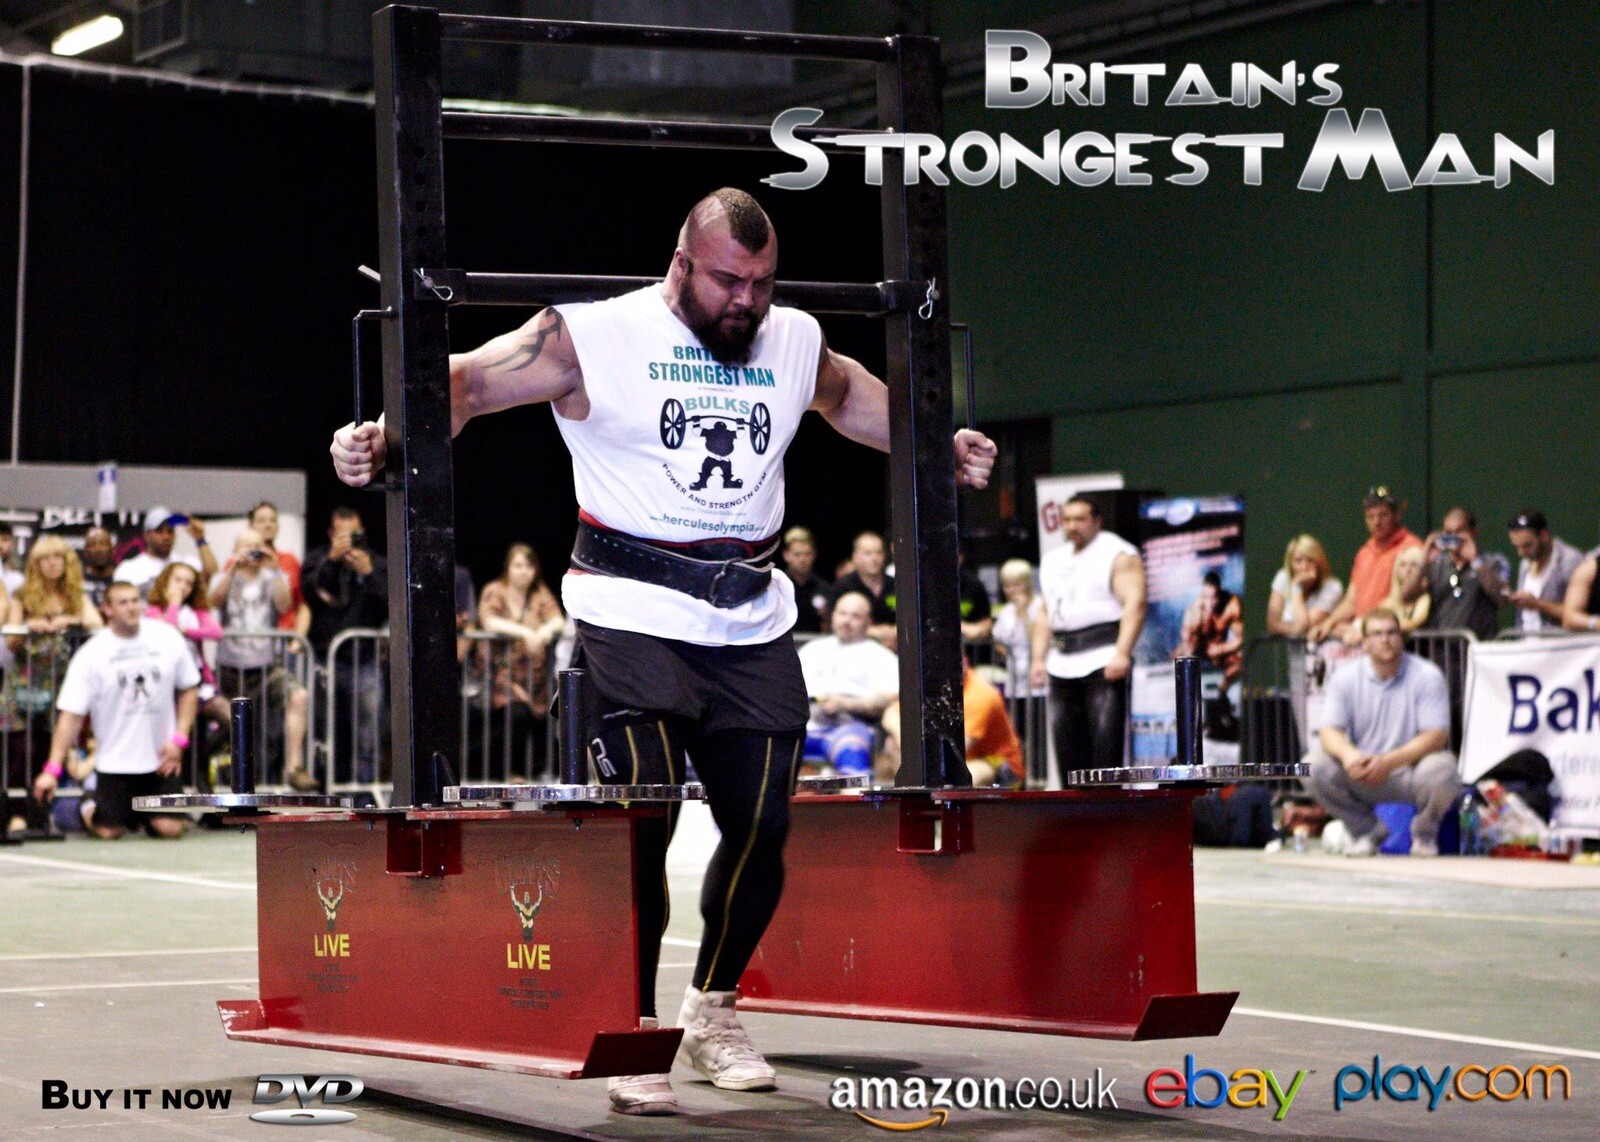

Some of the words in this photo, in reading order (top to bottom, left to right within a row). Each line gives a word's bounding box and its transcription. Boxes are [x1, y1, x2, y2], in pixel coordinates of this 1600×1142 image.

[649, 362, 740, 386] STRONGEST
[744, 367, 776, 388] MAN
[684, 395, 750, 415] BULKS
[662, 463, 687, 495] POWER
[688, 494, 707, 506] AND
[709, 491, 754, 509] STRENGTH
[754, 472, 767, 492] GYM
[314, 933, 350, 957] LIVE
[506, 943, 551, 970] LIVE
